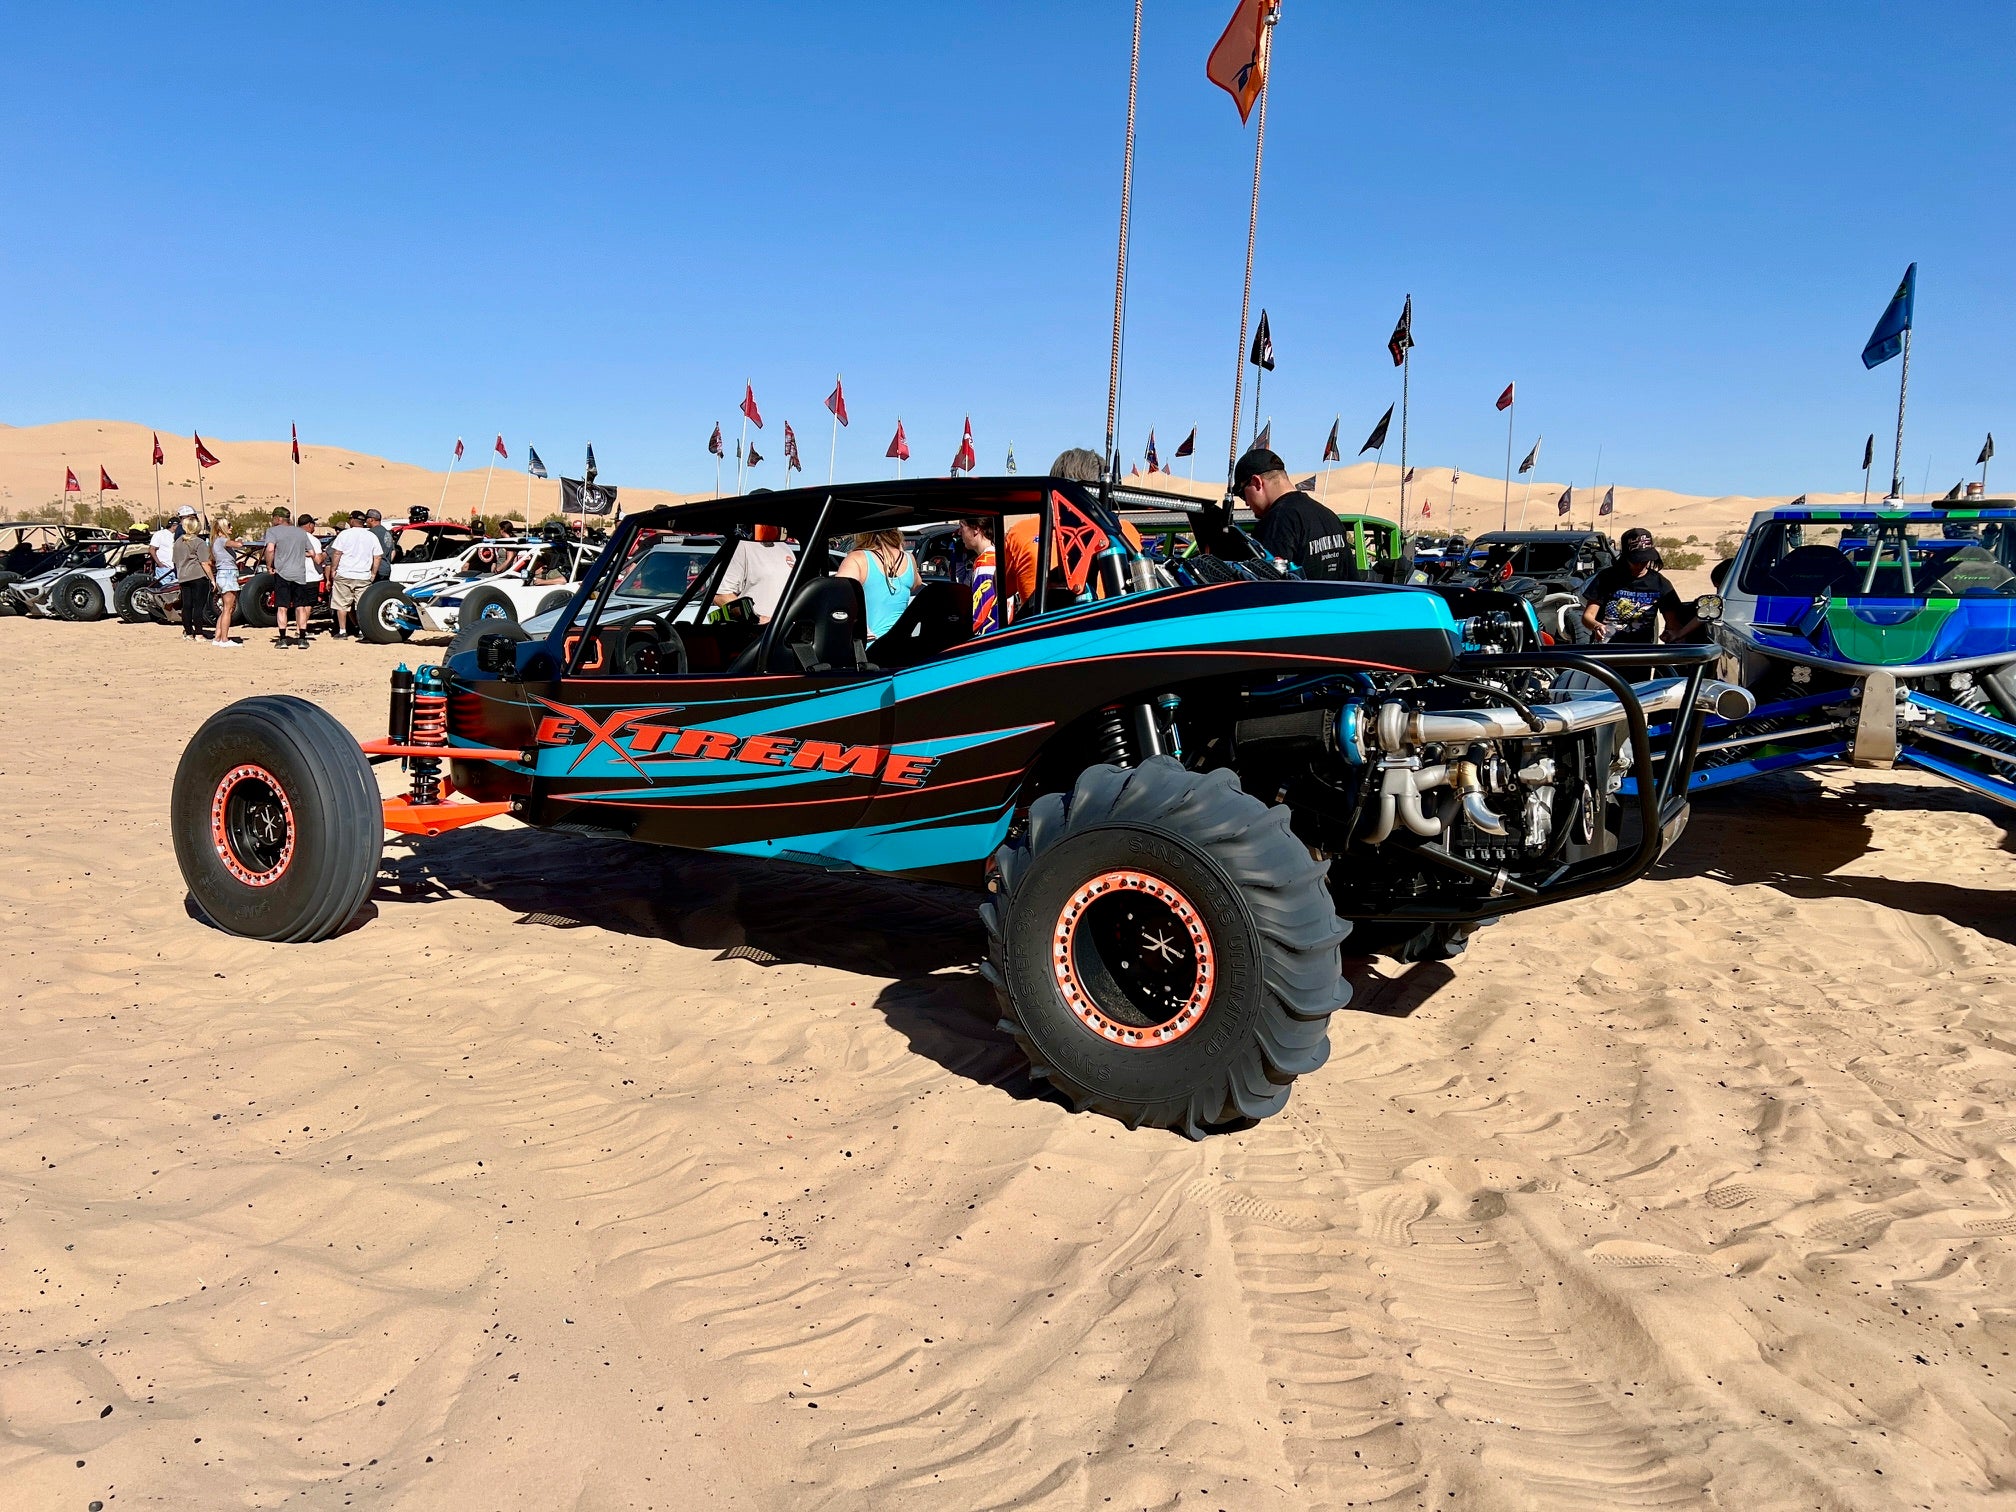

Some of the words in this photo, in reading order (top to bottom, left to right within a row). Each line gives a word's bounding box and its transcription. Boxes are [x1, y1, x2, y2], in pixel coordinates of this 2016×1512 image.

[527, 693, 941, 788] EXTREME
[1128, 837, 1185, 868] SAND
[1189, 863, 1236, 926] TIRES
[1015, 944, 1056, 1039] BLASTER
[1205, 935, 1248, 1057] UNLIMITED
[1059, 1042, 1112, 1082] SAND
